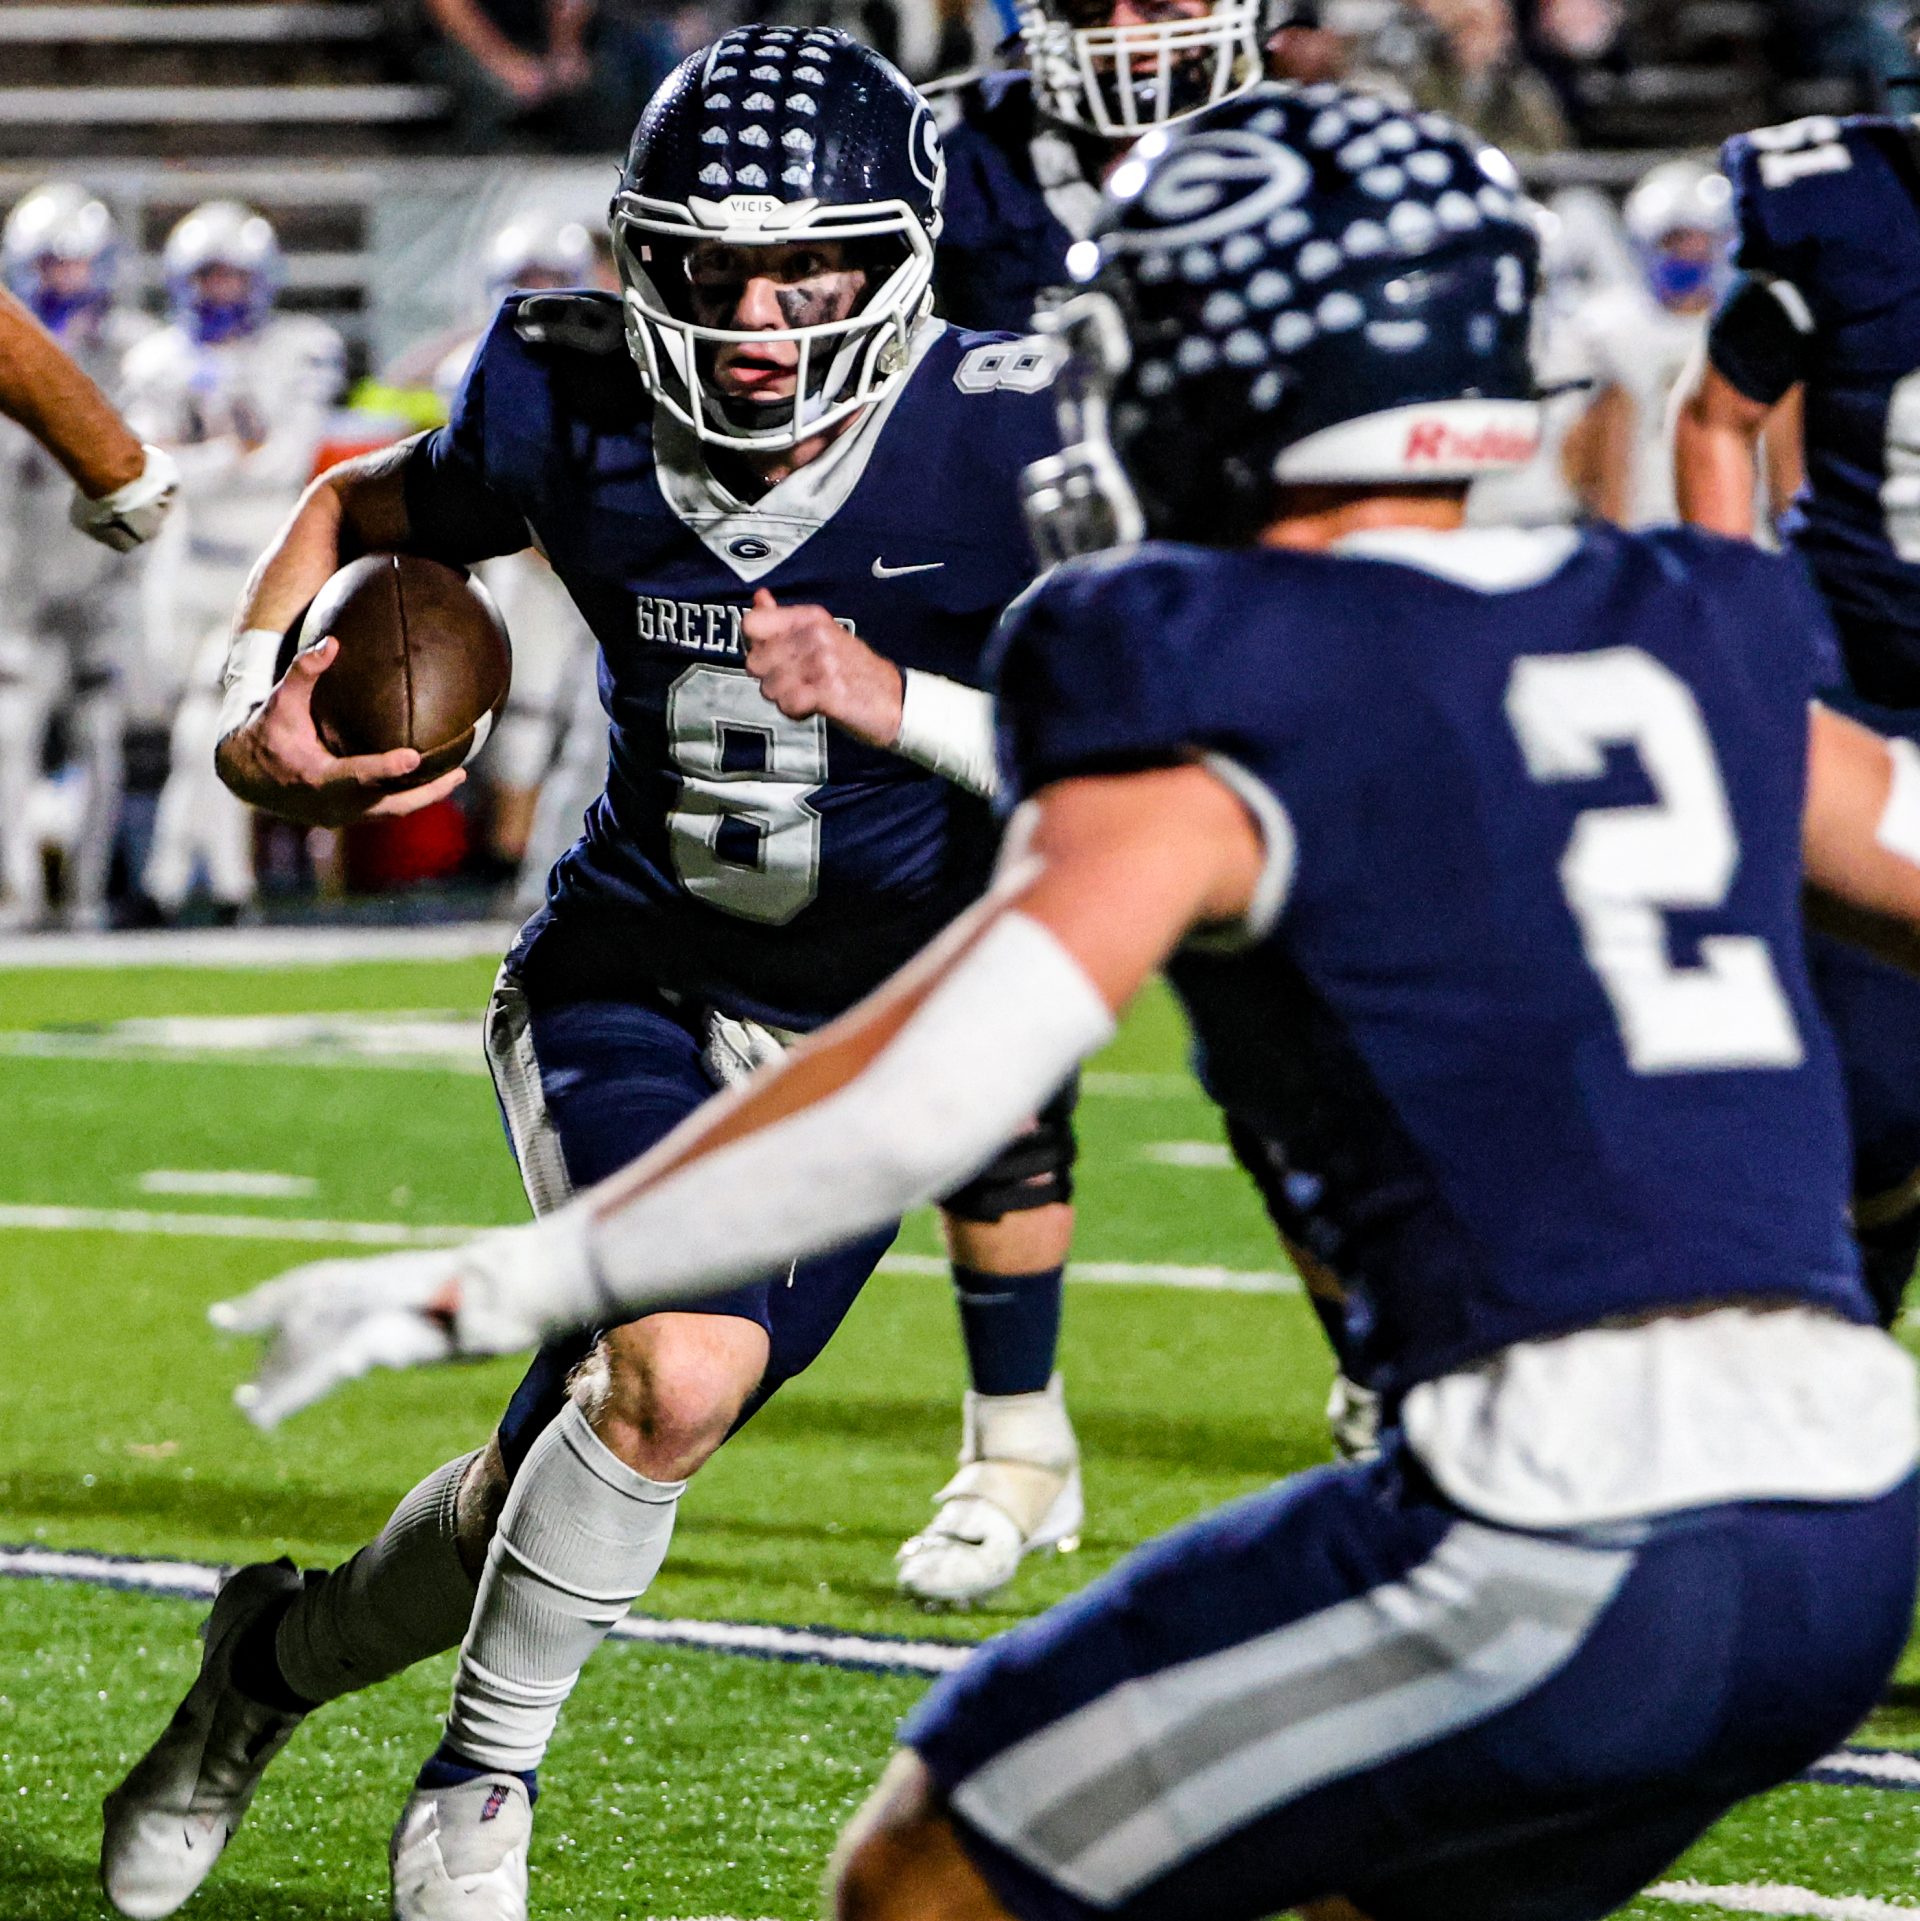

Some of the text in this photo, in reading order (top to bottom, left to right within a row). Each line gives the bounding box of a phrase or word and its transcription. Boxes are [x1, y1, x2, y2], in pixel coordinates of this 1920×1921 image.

[730, 201, 773, 213] VICIS
[952, 334, 1070, 394] 8
[666, 662, 828, 927] 8
[1503, 644, 1804, 1077] 2
